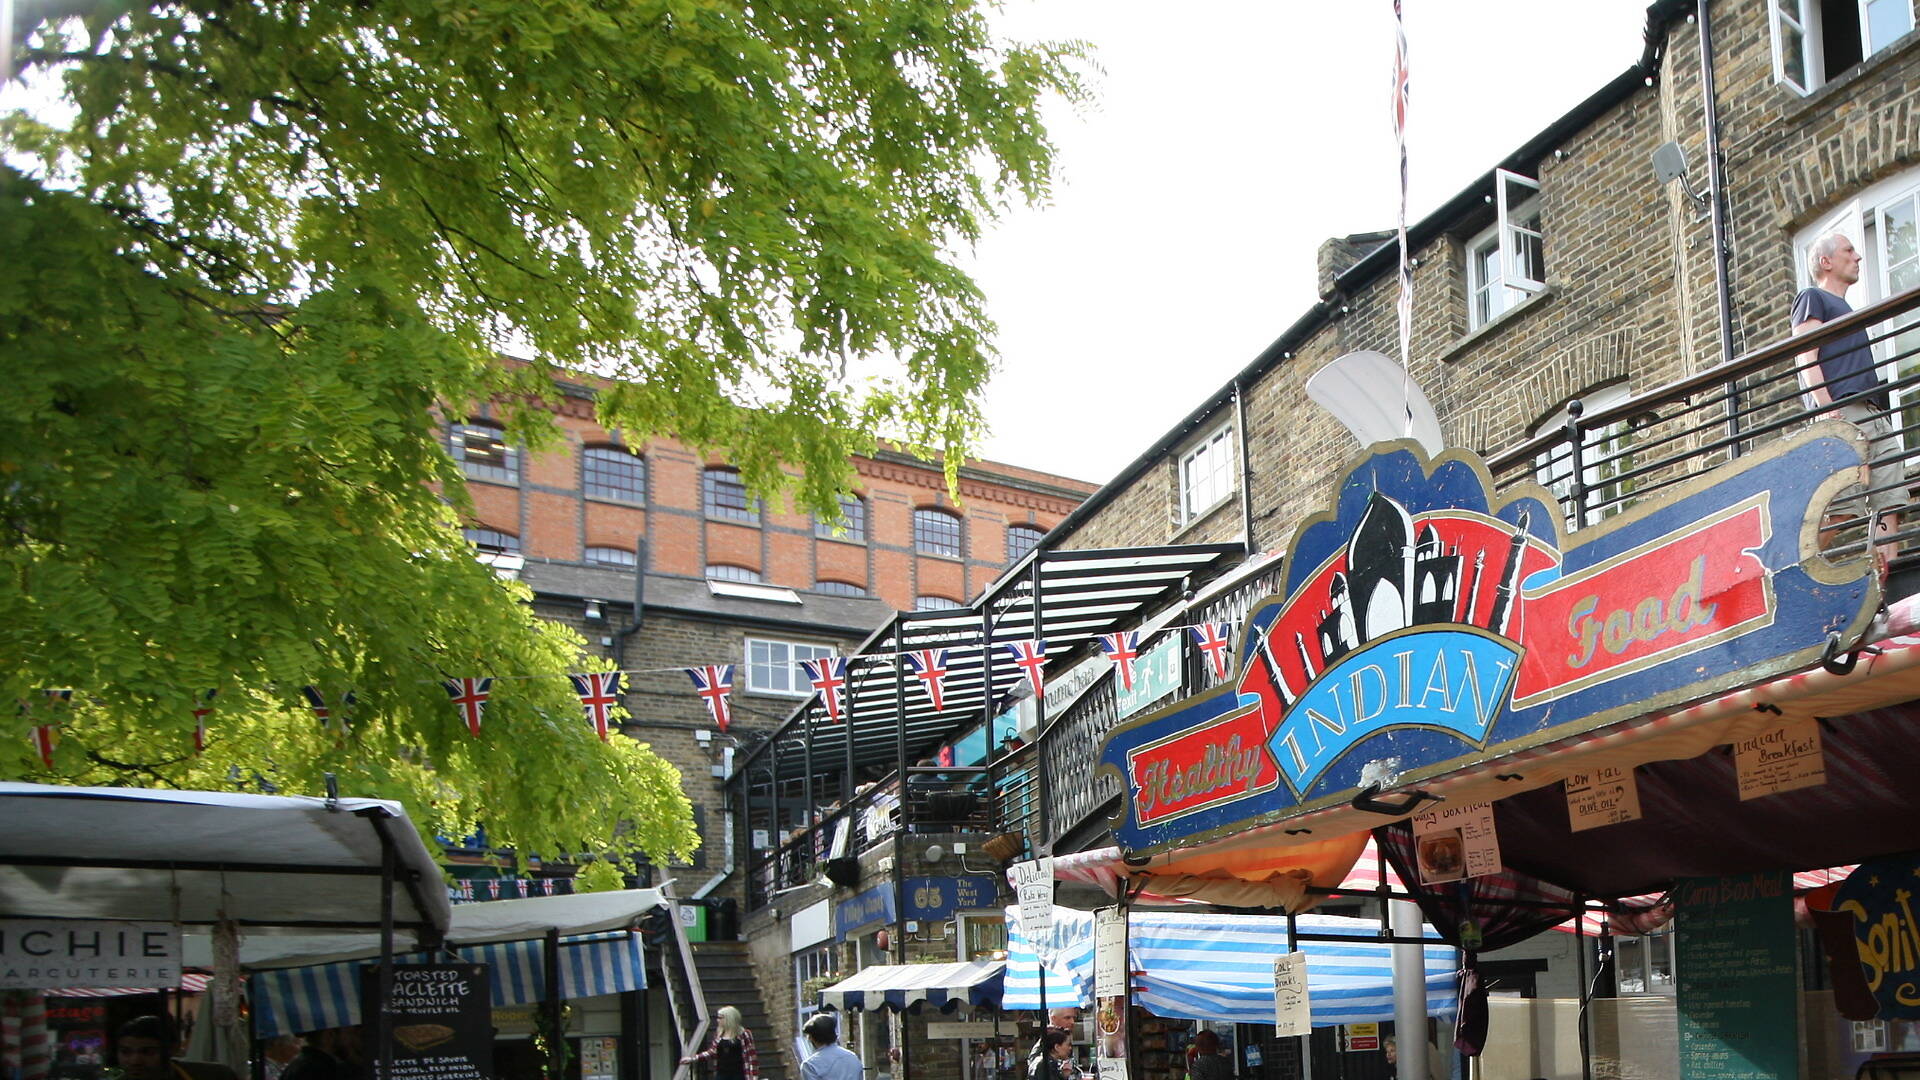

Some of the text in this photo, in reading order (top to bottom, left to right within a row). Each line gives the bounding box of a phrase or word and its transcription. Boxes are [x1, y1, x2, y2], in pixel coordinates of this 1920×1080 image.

[1567, 552, 1718, 670] Food
[1280, 648, 1511, 777] INDIAN
[1735, 729, 1785, 756] Indian
[1758, 737, 1815, 762] Breakfast
[1142, 734, 1264, 811] Healthy
[1601, 800, 1617, 809] OIL
[957, 879, 973, 888] The
[914, 888, 943, 909] 65
[957, 889, 978, 897] West
[957, 897, 977, 907] Yard
[0, 930, 168, 957] CHIE
[393, 970, 459, 982] TOASTED
[391, 980, 471, 996] ACLETTE
[391, 997, 460, 1007] SANDWICH
